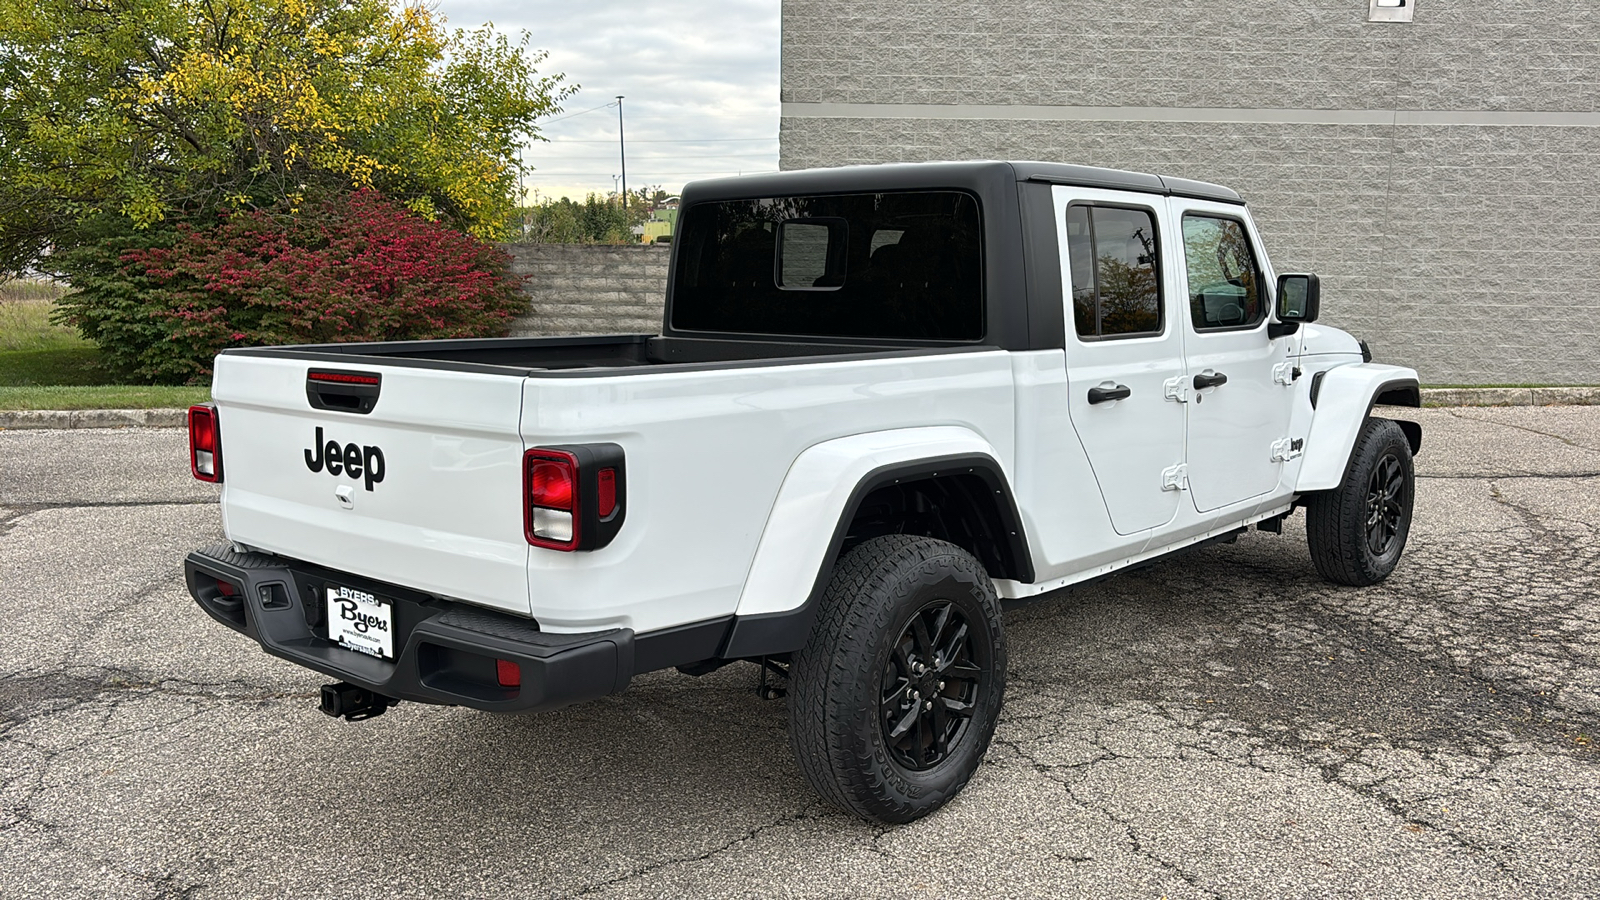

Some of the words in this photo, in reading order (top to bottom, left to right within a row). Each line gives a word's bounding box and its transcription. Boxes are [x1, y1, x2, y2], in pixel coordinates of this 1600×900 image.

[304, 426, 386, 492] Jeep
[340, 587, 375, 604] BYERS
[333, 598, 387, 633] Byers
